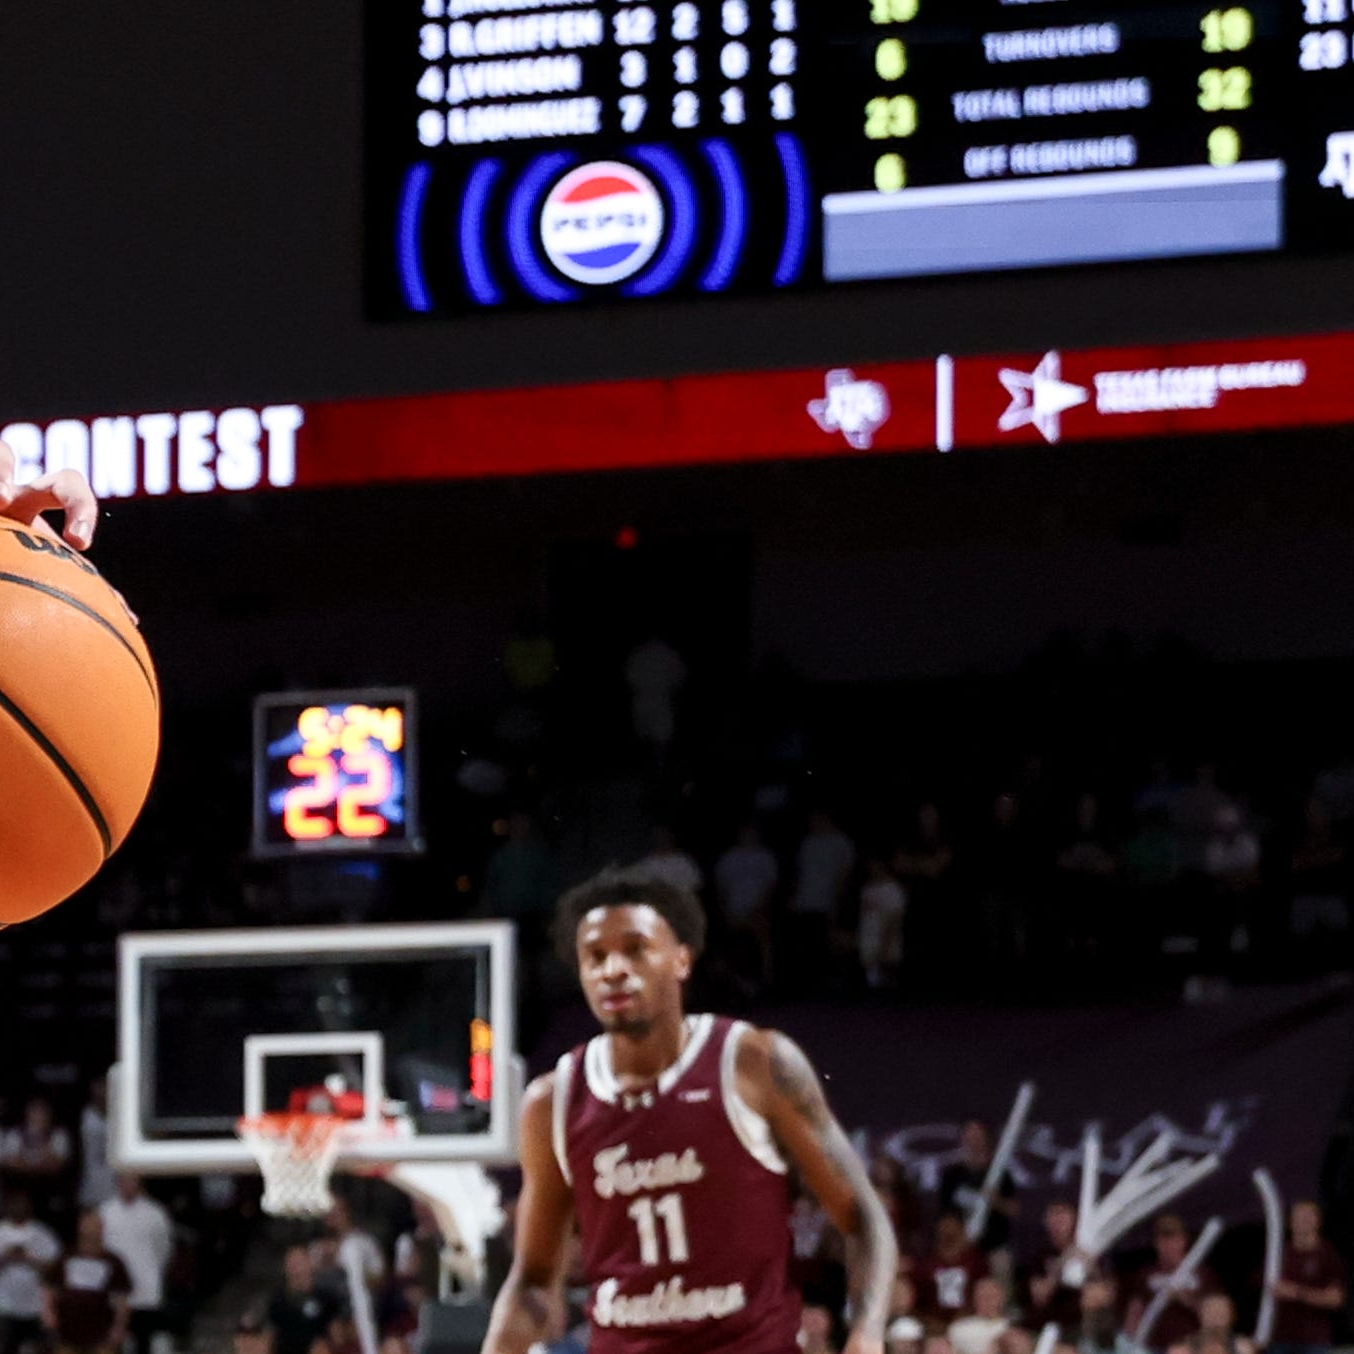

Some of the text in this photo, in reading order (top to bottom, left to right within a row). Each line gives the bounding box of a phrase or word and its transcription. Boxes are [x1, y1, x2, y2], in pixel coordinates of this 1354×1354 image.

[419, 22, 445, 60] 3
[613, 6, 656, 46] 12
[671, 2, 699, 41] 2
[771, 0, 796, 32] 1
[982, 21, 1121, 63] TURNOVERS
[416, 65, 445, 103] 4
[619, 49, 647, 88] 3
[673, 45, 698, 84] 1
[720, 40, 750, 80] 0
[768, 37, 797, 76] 2
[618, 94, 647, 133] 7
[671, 90, 700, 128] 2
[720, 86, 746, 124] 1
[769, 81, 795, 120] 1
[864, 66, 1253, 140] 23 TOTAL REBOUNDS 32
[963, 143, 1009, 179] OFF
[1010, 134, 1138, 174] REBOUNDS
[553, 212, 647, 233] PEPSI
[284, 752, 391, 841] 22
[593, 1144, 704, 1199] Texas
[628, 1194, 689, 1267] 11
